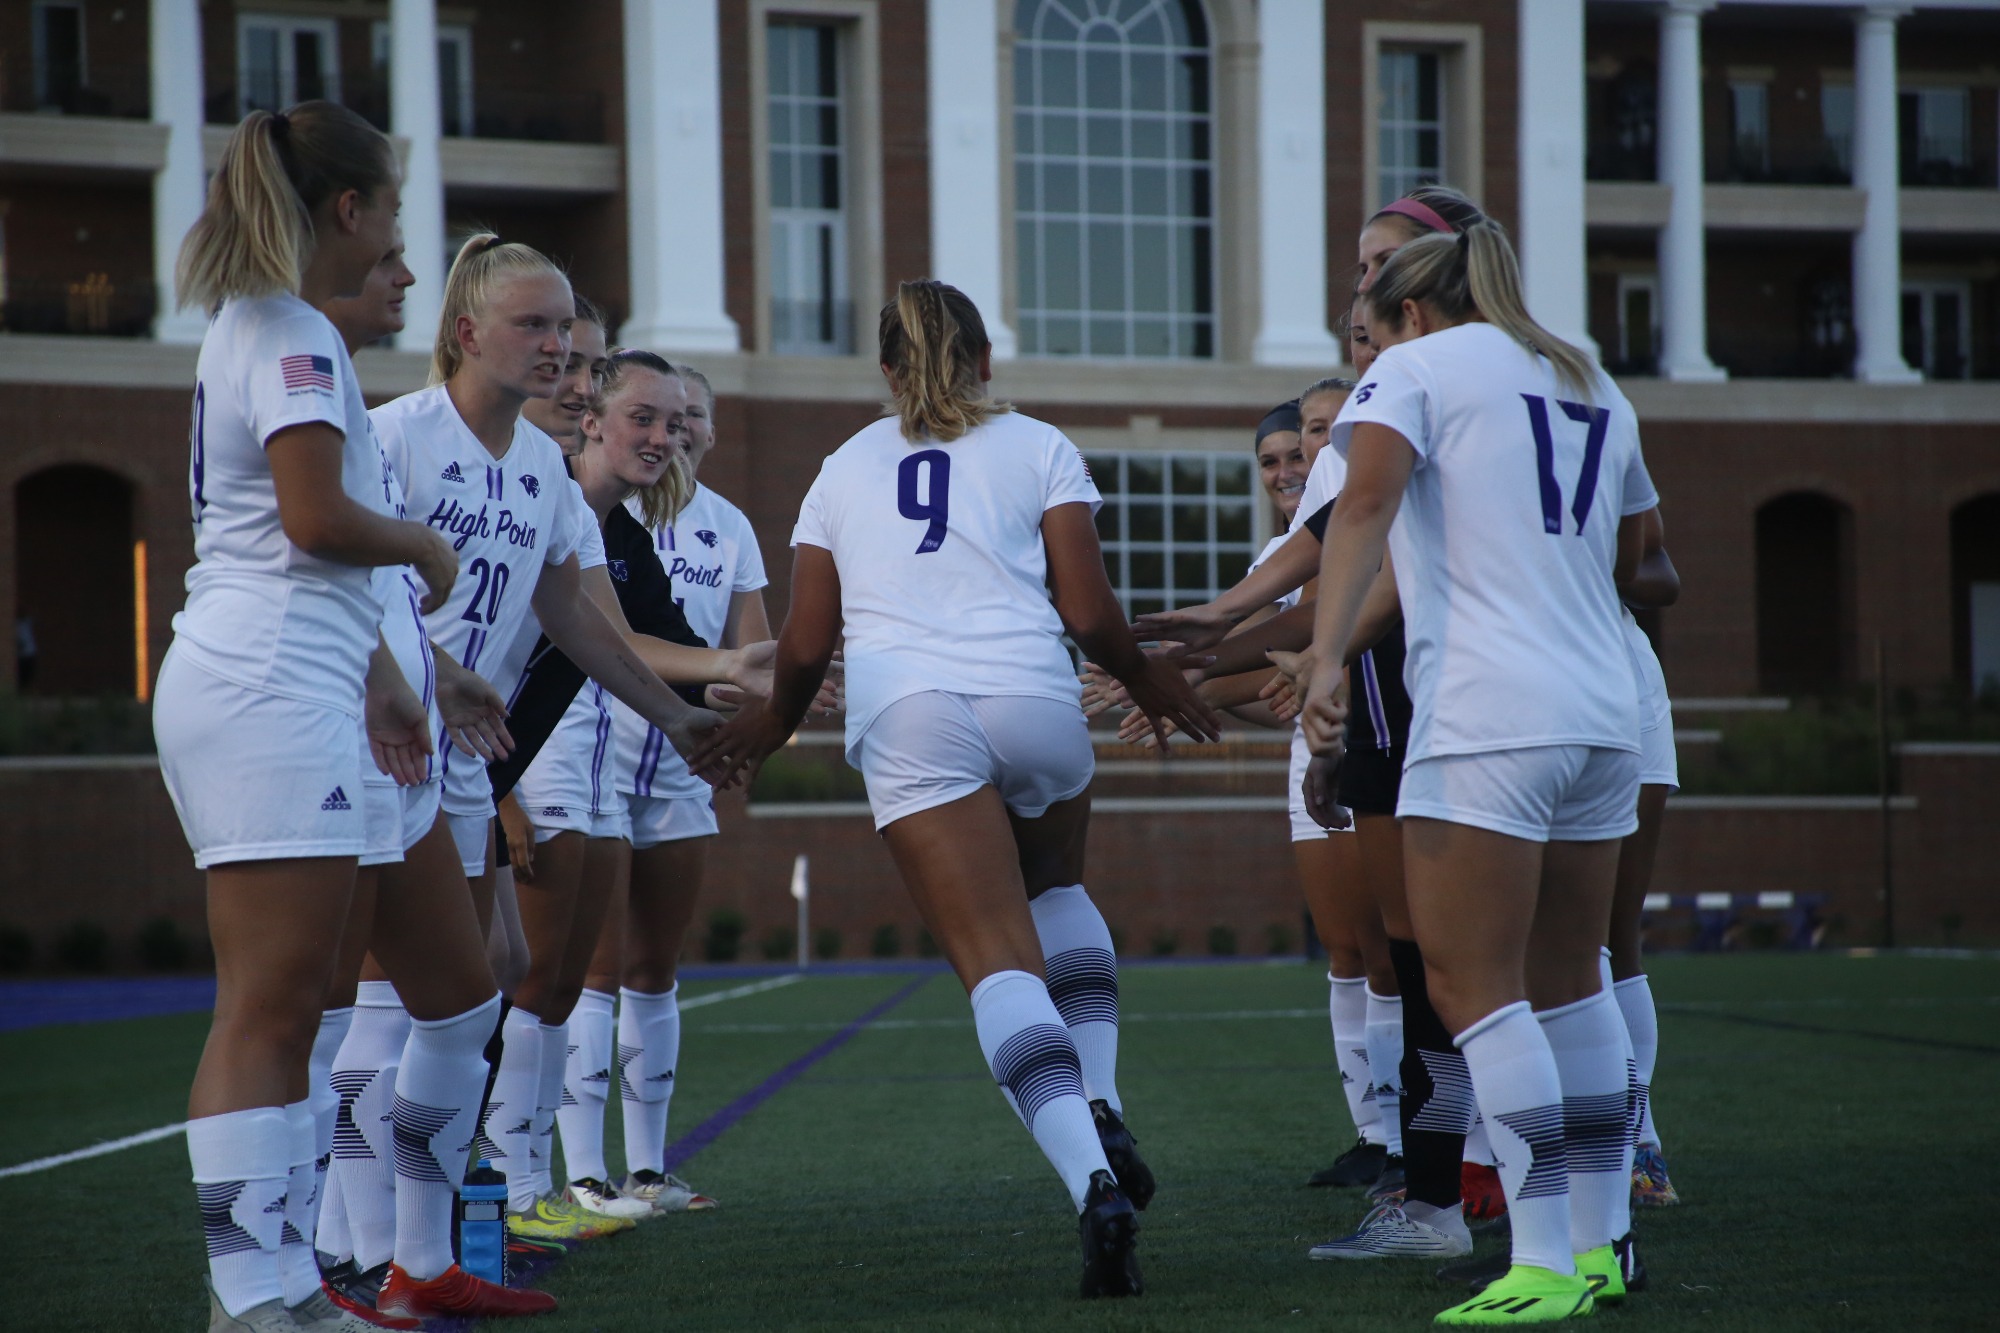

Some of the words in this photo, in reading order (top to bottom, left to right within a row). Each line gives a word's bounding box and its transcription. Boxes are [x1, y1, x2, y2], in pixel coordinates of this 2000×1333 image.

[441, 472, 465, 484] adidas
[1518, 393, 1610, 536] 17
[897, 449, 951, 555] 9
[427, 497, 490, 552] High
[495, 509, 537, 550] Poin
[461, 557, 509, 626] 20
[669, 557, 724, 588] Point
[321, 801, 352, 811] adidas
[543, 809, 569, 818] adidas
